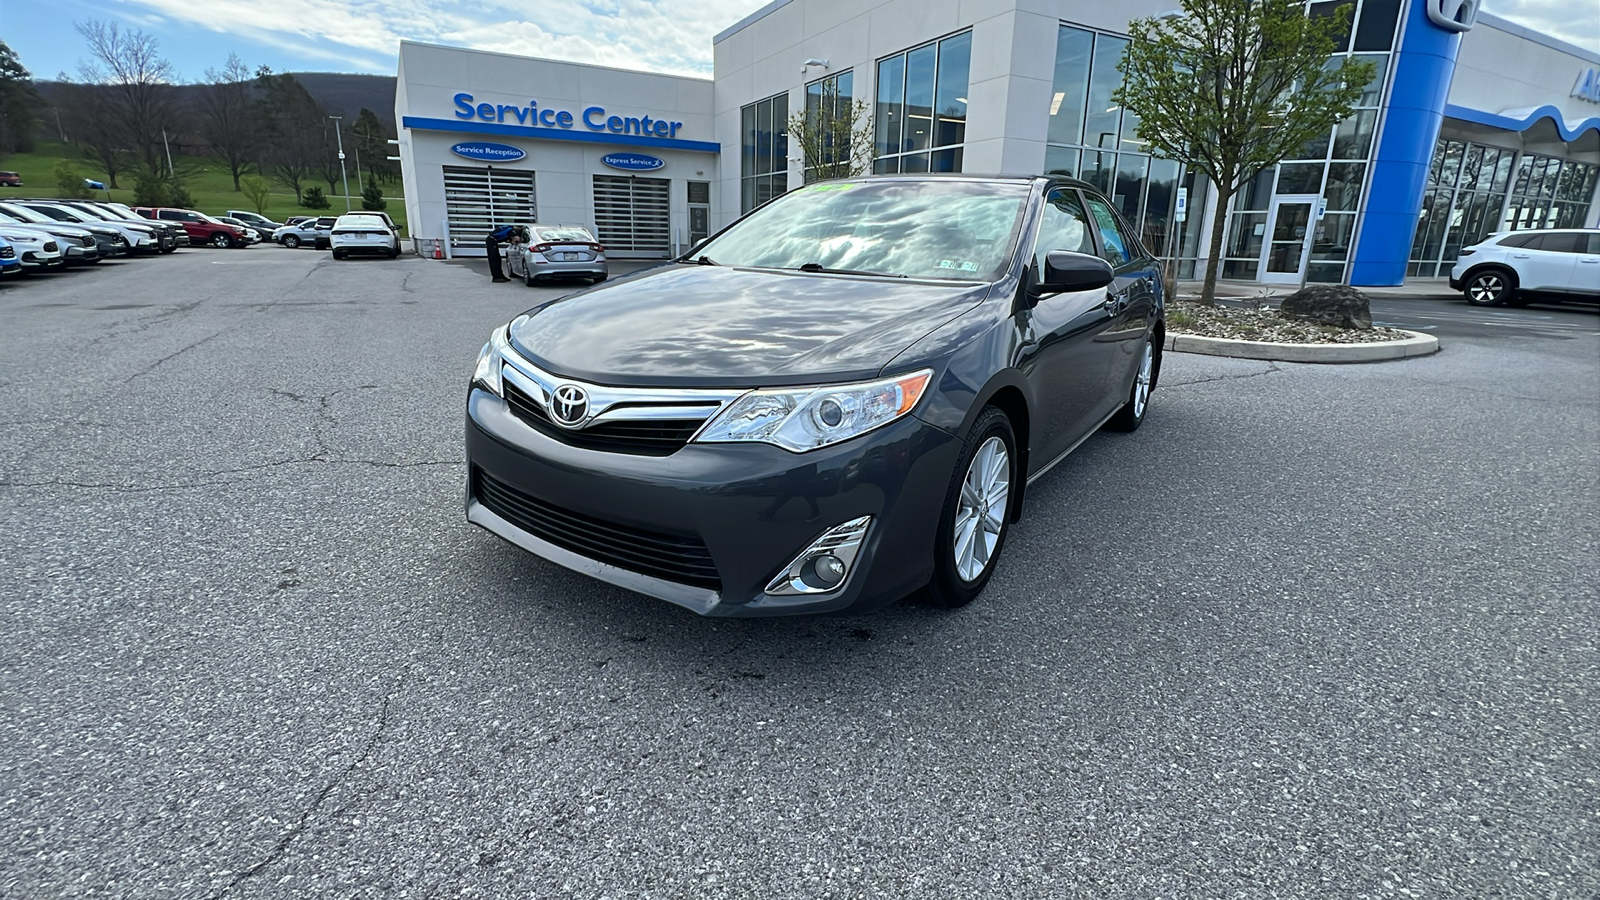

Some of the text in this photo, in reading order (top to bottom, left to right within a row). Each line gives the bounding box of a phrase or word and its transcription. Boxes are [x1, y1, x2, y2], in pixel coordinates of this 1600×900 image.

[453, 92, 683, 138] Service Center
[456, 145, 521, 157] Service Reception
[605, 156, 652, 166] Express Service
